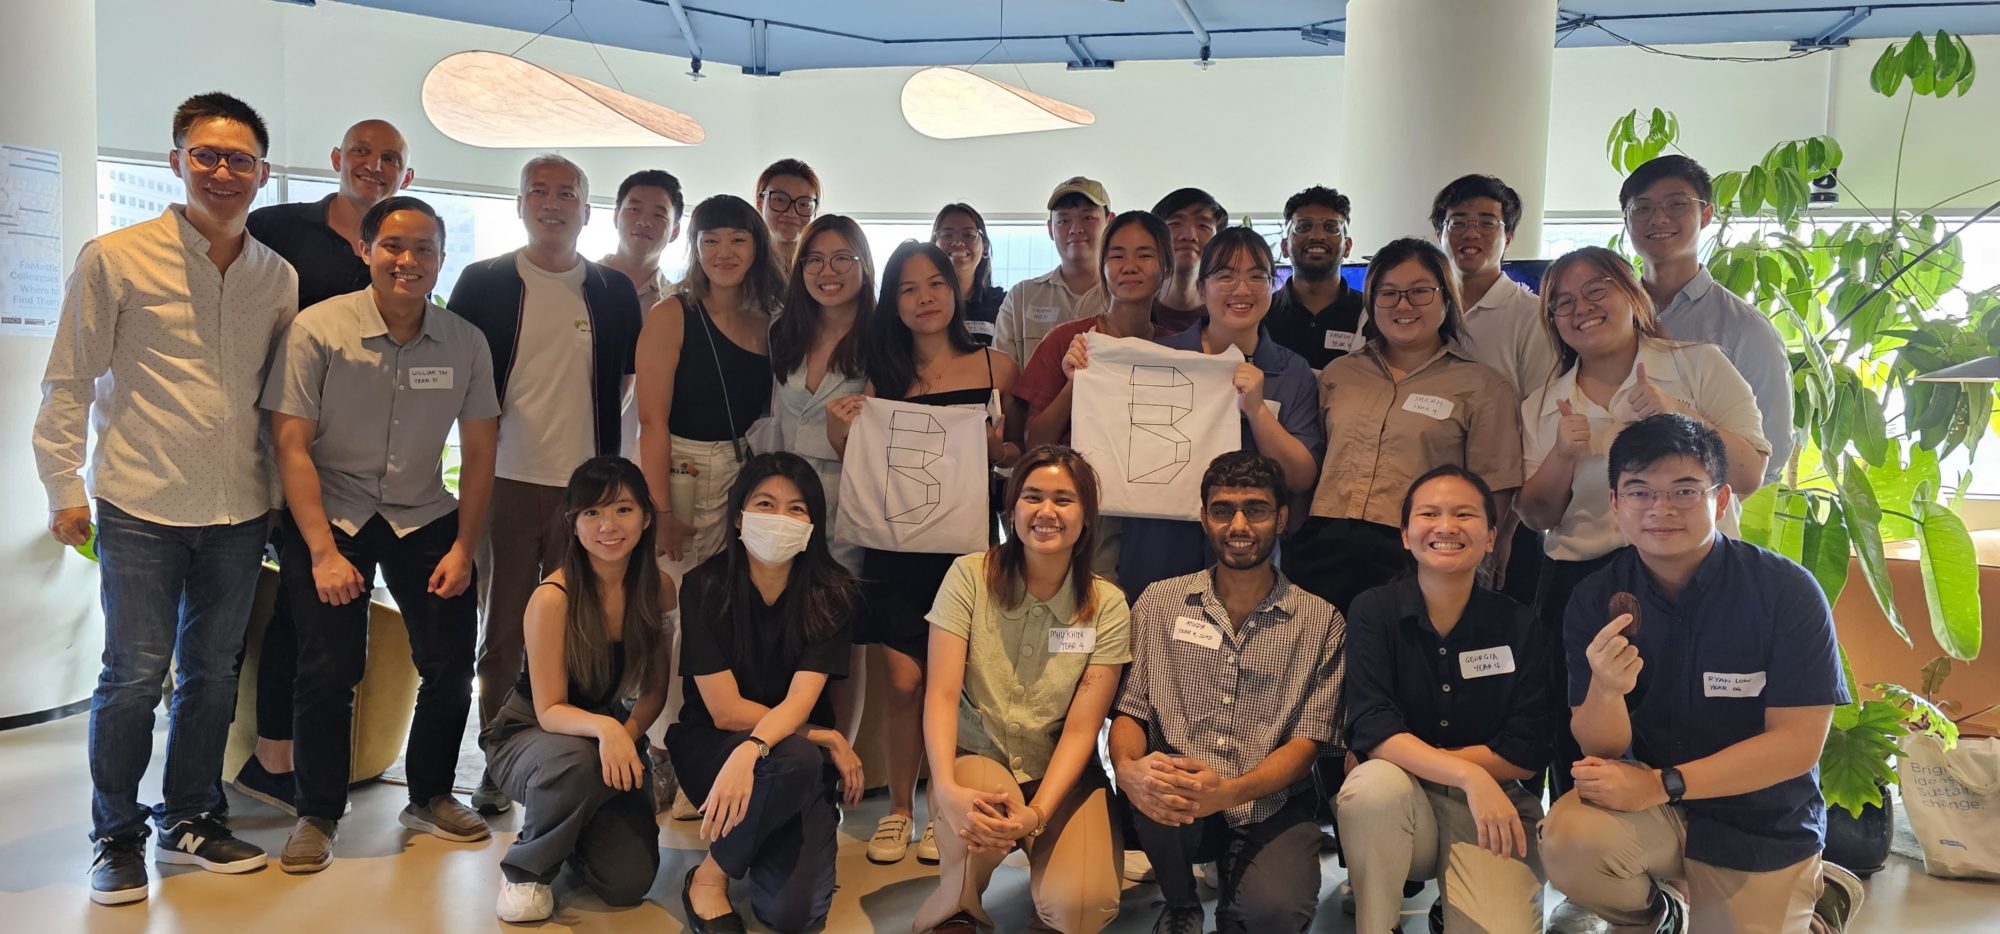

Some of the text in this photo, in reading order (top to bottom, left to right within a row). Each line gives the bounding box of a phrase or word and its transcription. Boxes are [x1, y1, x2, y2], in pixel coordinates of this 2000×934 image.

[19, 260, 59, 272] Fantastic
[20, 284, 59, 296] Where to
[13, 295, 59, 306] Find Them
[1061, 642, 1077, 650] YEAR
[1465, 653, 1499, 663] GEORGIA
[1474, 663, 1492, 672] YEAR
[1708, 675, 1731, 684] RYAN
[176, 831, 206, 855] N
